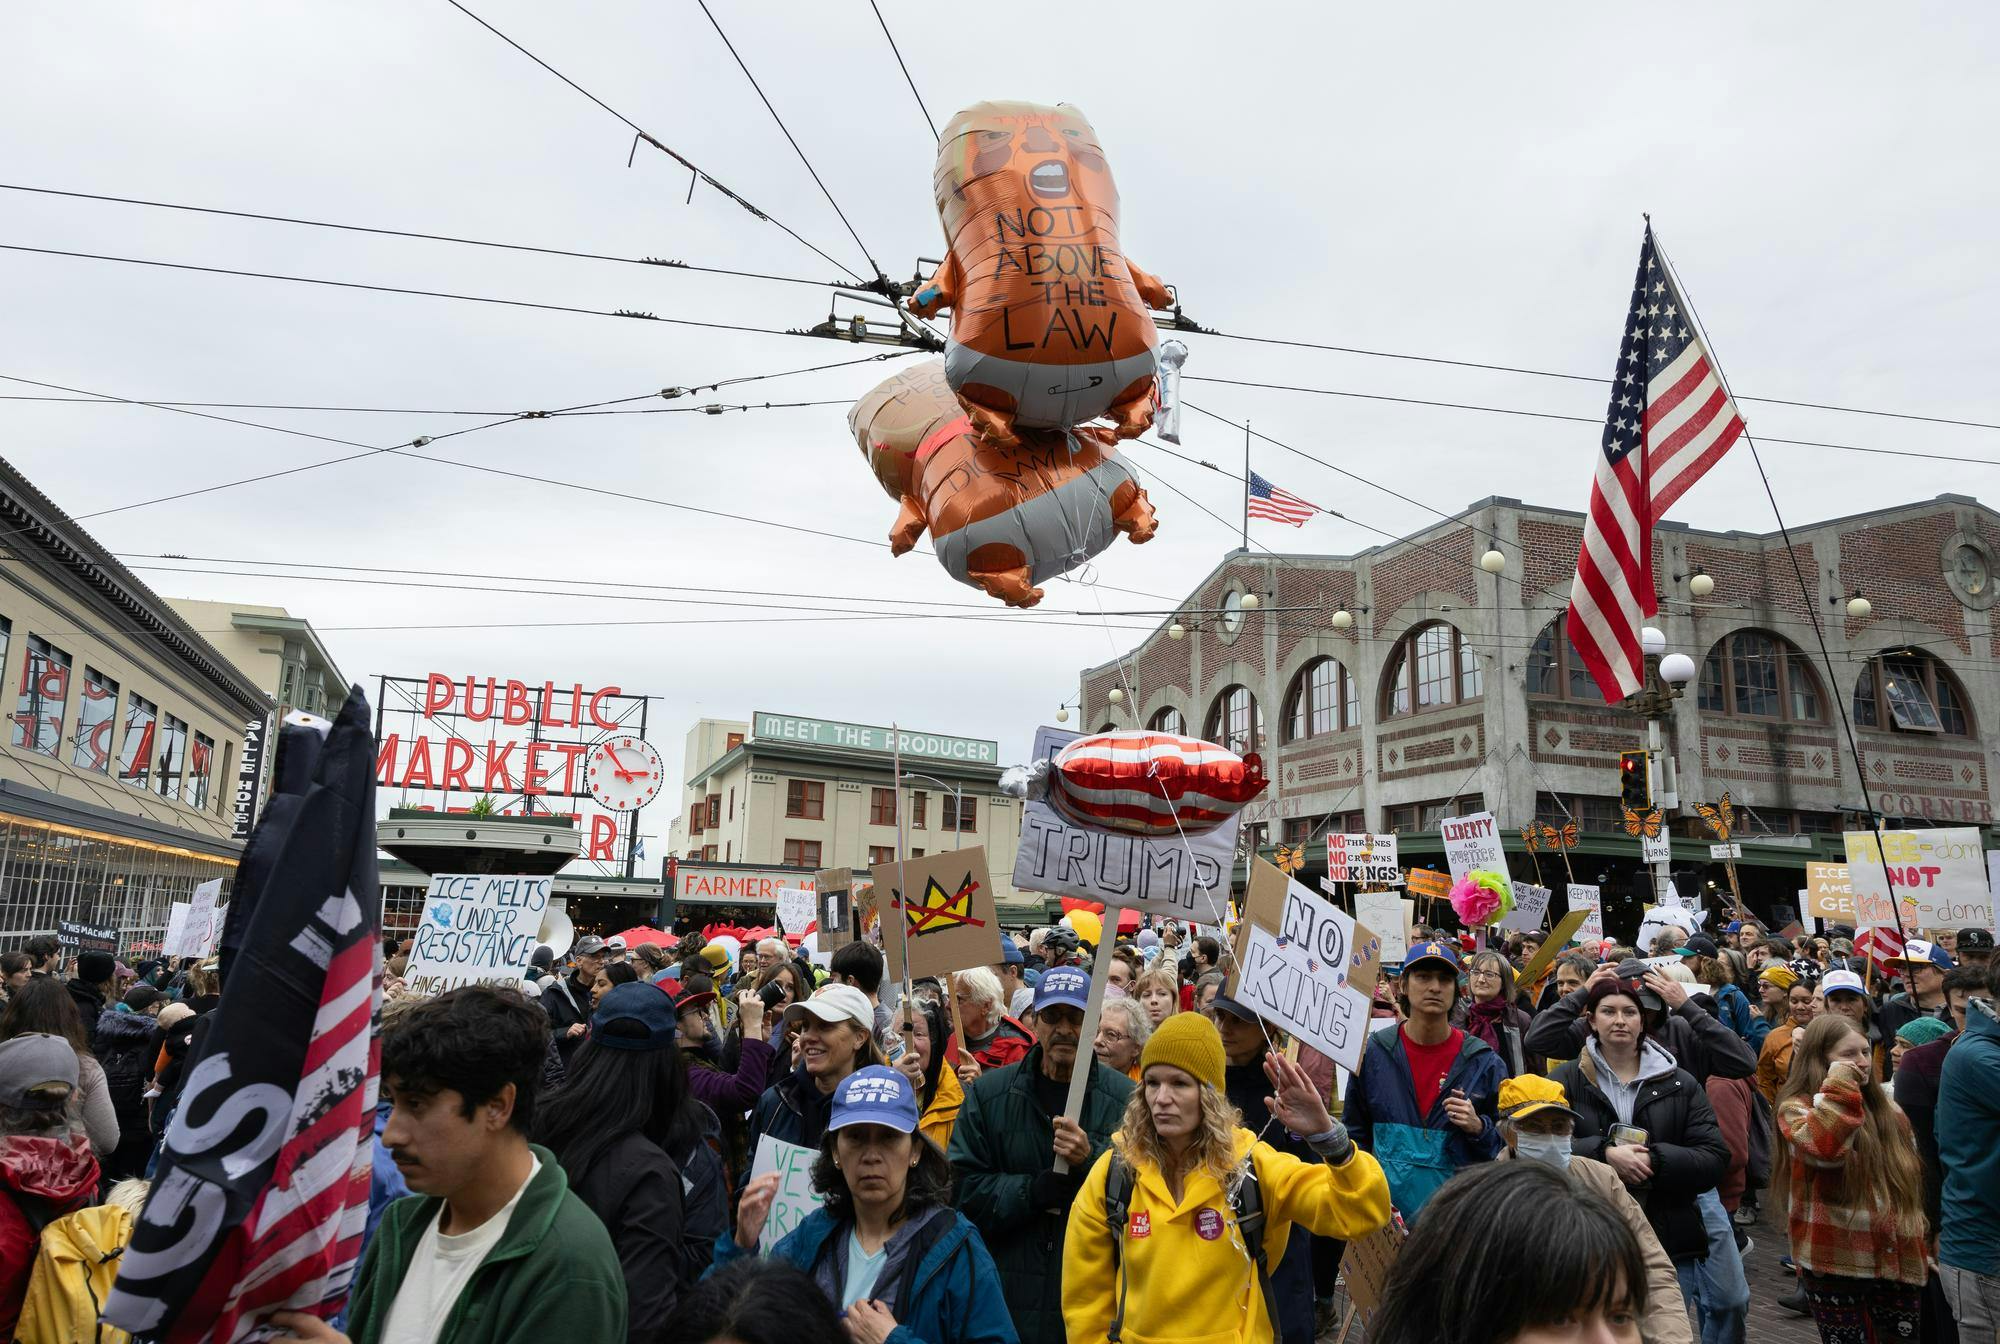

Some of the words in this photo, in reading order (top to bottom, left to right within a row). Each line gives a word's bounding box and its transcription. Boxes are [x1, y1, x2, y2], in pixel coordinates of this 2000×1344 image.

[995, 206, 1083, 243] NOT
[994, 243, 1120, 281] ABOVE
[1031, 281, 1105, 306] THE
[1004, 308, 1117, 350] LAW
[423, 672, 622, 730] PUBLIC
[623, 739, 631, 747] 12
[765, 718, 821, 740] MEET
[835, 725, 872, 747] THE
[885, 733, 990, 760] PRODUCER
[376, 733, 588, 797] MARKET
[590, 768, 596, 776] 9
[653, 772, 658, 780] 3
[593, 784, 598, 792] 8
[647, 787, 653, 795] 4
[232, 780, 253, 834] HOTEL
[1879, 793, 1993, 823] CORNER
[1443, 818, 1493, 842] LIBERTY
[1328, 835, 1346, 848] NO
[1345, 839, 1391, 848] THRNES
[1464, 841, 1478, 849] AND
[1030, 819, 1221, 909] TRUMP
[1329, 851, 1347, 865] NO
[1347, 854, 1392, 862] CRWNS
[1450, 847, 1497, 864] JUSTICE
[1645, 848, 1669, 858] TURNS
[1330, 866, 1348, 880] NO
[1347, 866, 1397, 881] KNGS
[1886, 866, 1941, 888] NOT
[429, 877, 480, 900] ICE
[481, 879, 550, 911] MELTS
[685, 875, 786, 898] FARMERS
[1514, 884, 1528, 895] WE
[1529, 888, 1546, 899] WILL
[1569, 887, 1584, 900] KEEP
[1584, 889, 1600, 901] YOUR
[1819, 881, 1853, 894] AME
[1515, 893, 1526, 902] NOT
[1529, 897, 1544, 907] STAY
[1517, 901, 1544, 915] ILENT!
[62, 922, 80, 934] THIS
[80, 926, 116, 939] MACHINE
[456, 905, 518, 936] UNDER
[1284, 893, 1344, 969] NO
[57, 934, 79, 945] KILLS
[412, 923, 536, 968] RESISTANCE
[403, 964, 447, 995] CHINGA
[1243, 942, 1353, 1050] KING
